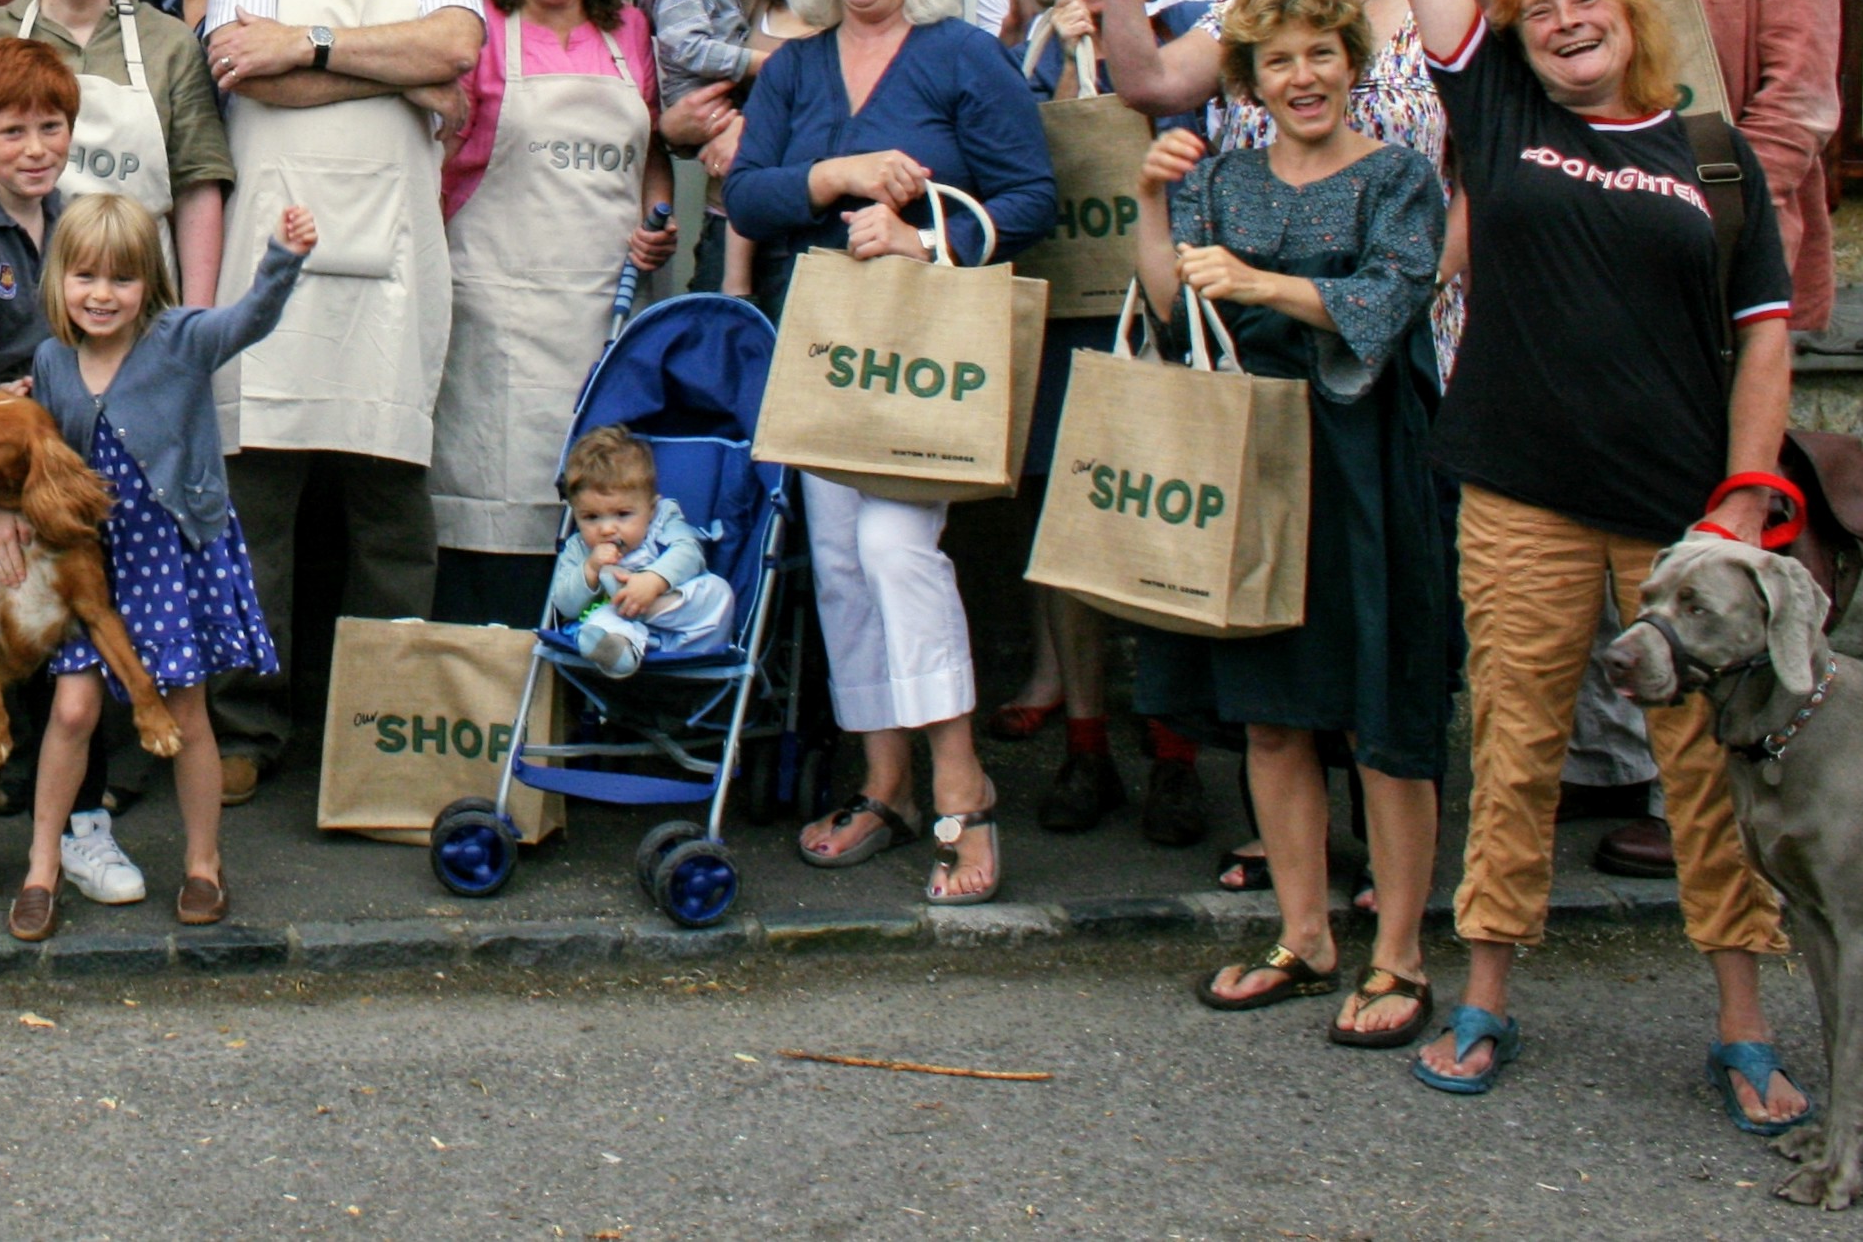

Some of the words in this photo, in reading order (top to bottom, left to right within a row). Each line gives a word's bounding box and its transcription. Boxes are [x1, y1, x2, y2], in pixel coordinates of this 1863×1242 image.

[68, 145, 140, 181] HOP
[549, 141, 636, 173] SHOP
[1046, 195, 1139, 240] HOP
[824, 344, 986, 401] SHOP
[1088, 464, 1225, 529] SHOP
[375, 714, 514, 763] SHOP
